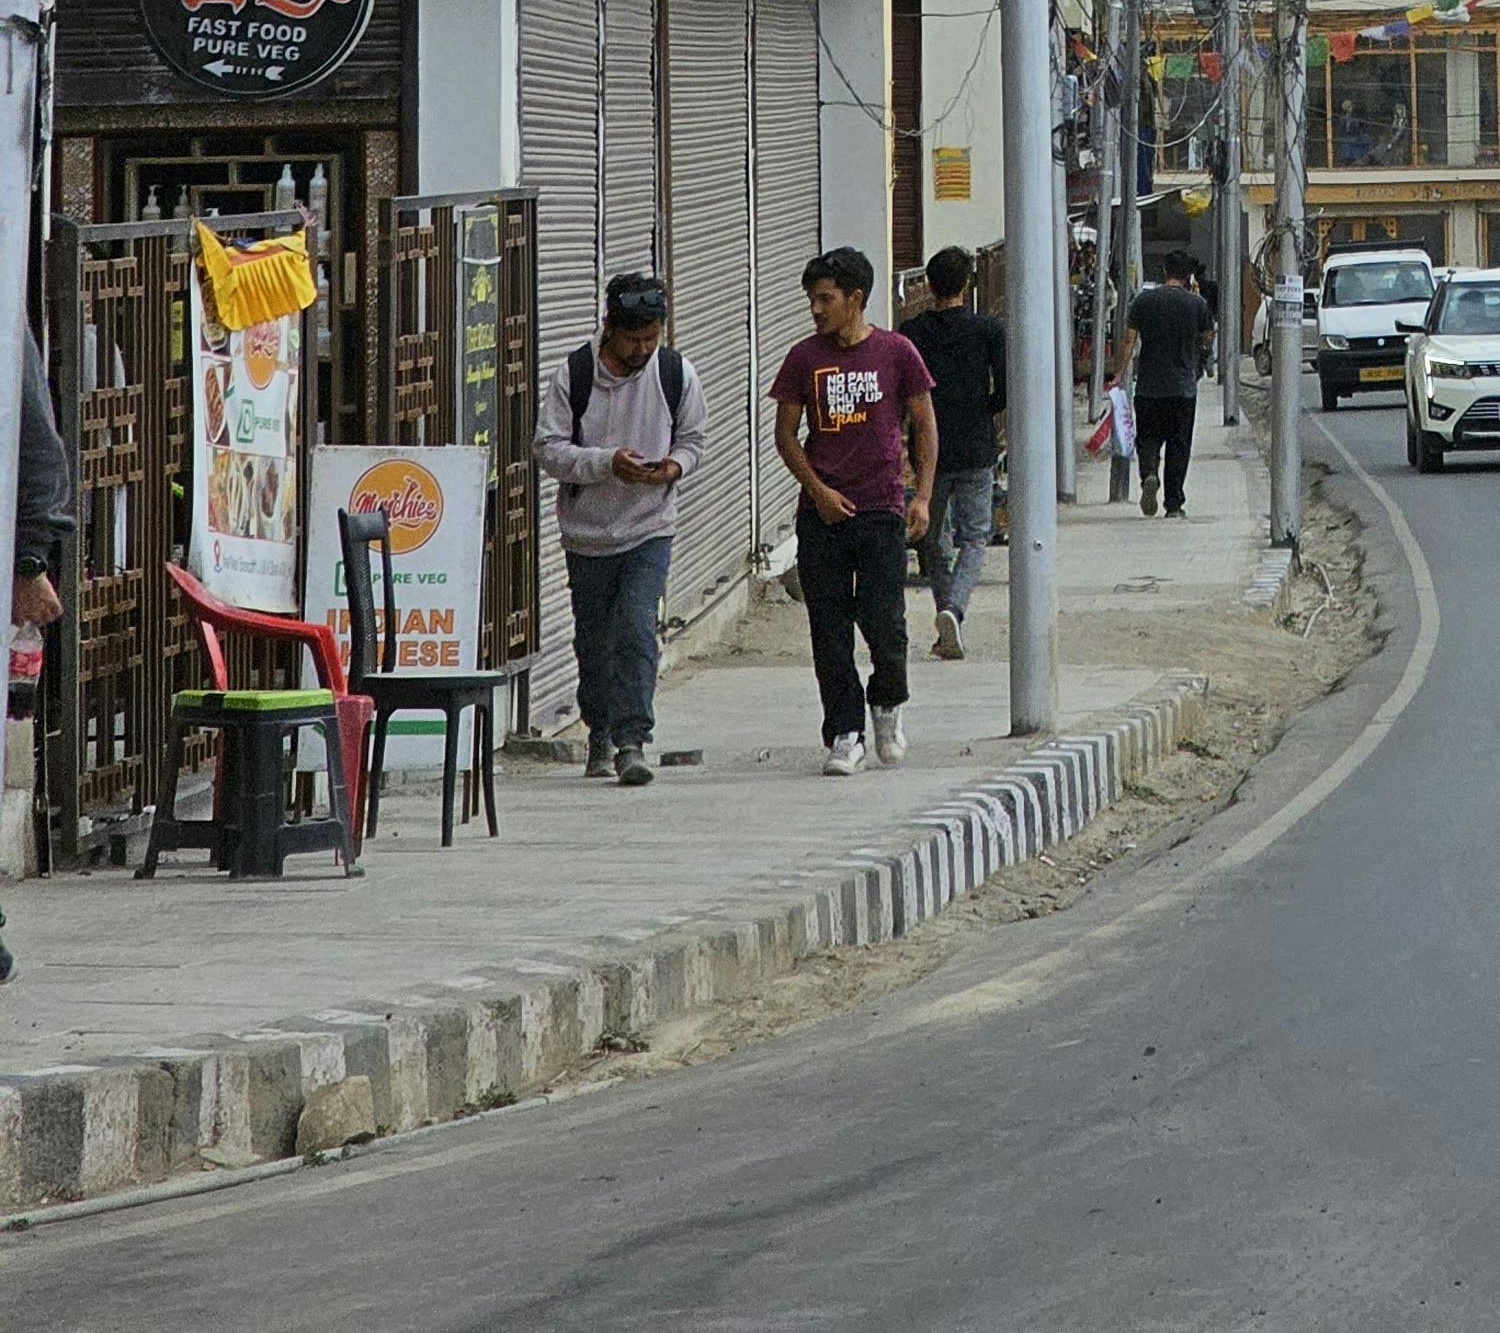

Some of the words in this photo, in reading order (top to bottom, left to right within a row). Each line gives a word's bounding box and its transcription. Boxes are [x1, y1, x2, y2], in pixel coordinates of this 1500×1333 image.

[187, 16, 242, 38] FAST
[247, 22, 308, 44] FOOD
[192, 36, 250, 58] PURE
[255, 43, 301, 62] VEG
[826, 372, 845, 385] NO
[847, 370, 878, 383] PAIN
[826, 383, 845, 395] NO
[847, 381, 878, 393] GAIN
[827, 392, 862, 406] SHUT
[865, 390, 883, 403] UP
[828, 403, 854, 416] AND
[372, 572, 415, 585] PRE
[417, 572, 448, 585] VEG
